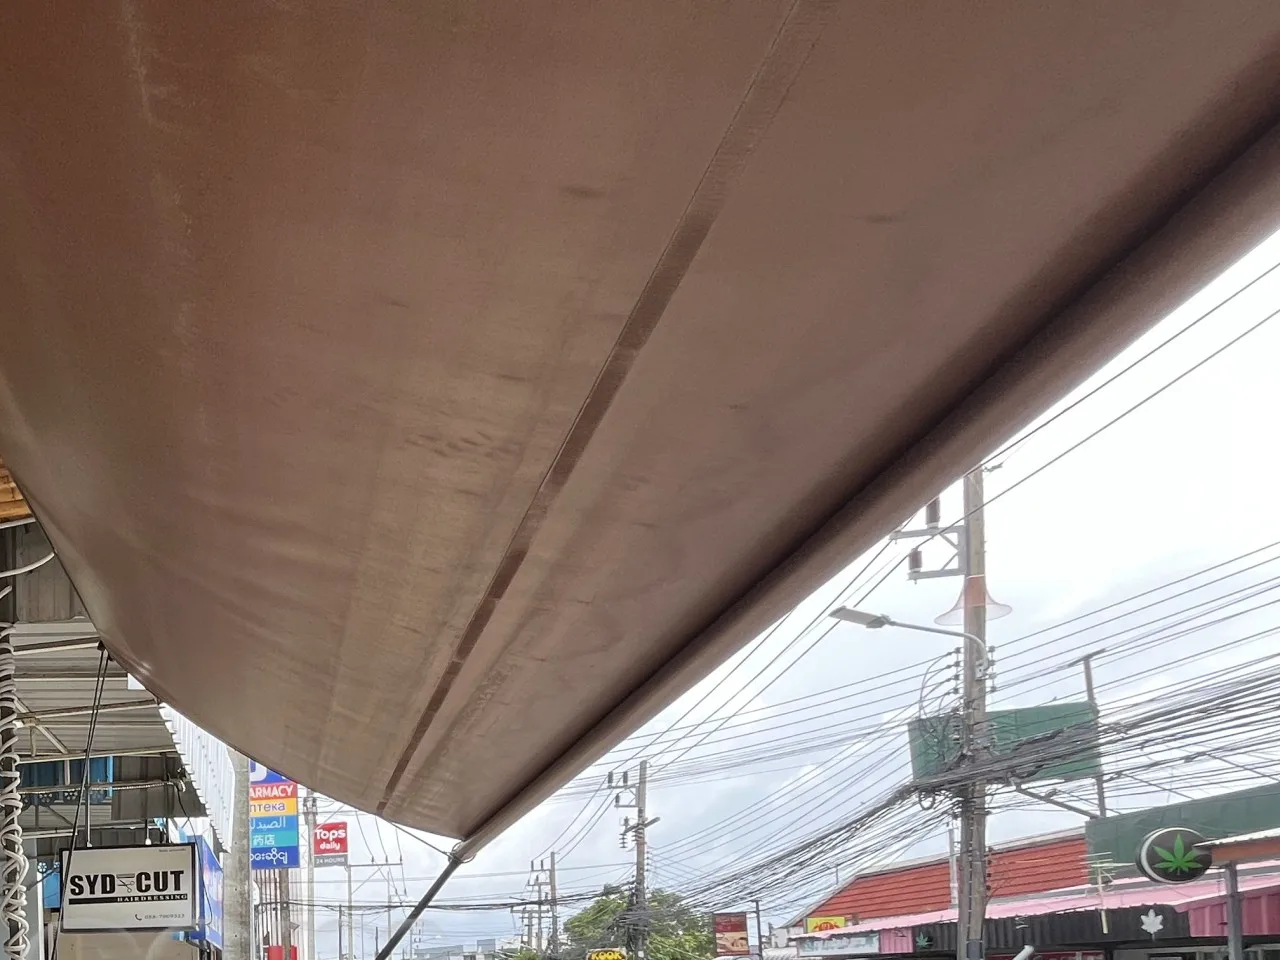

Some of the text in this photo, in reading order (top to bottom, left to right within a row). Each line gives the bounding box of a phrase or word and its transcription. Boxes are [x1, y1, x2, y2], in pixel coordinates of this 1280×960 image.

[315, 829, 346, 841] Tops
[320, 841, 341, 850] daily
[70, 870, 185, 896] SYD CUT
[117, 894, 187, 903] HAIRDRESSING
[591, 951, 623, 960] KOOK
